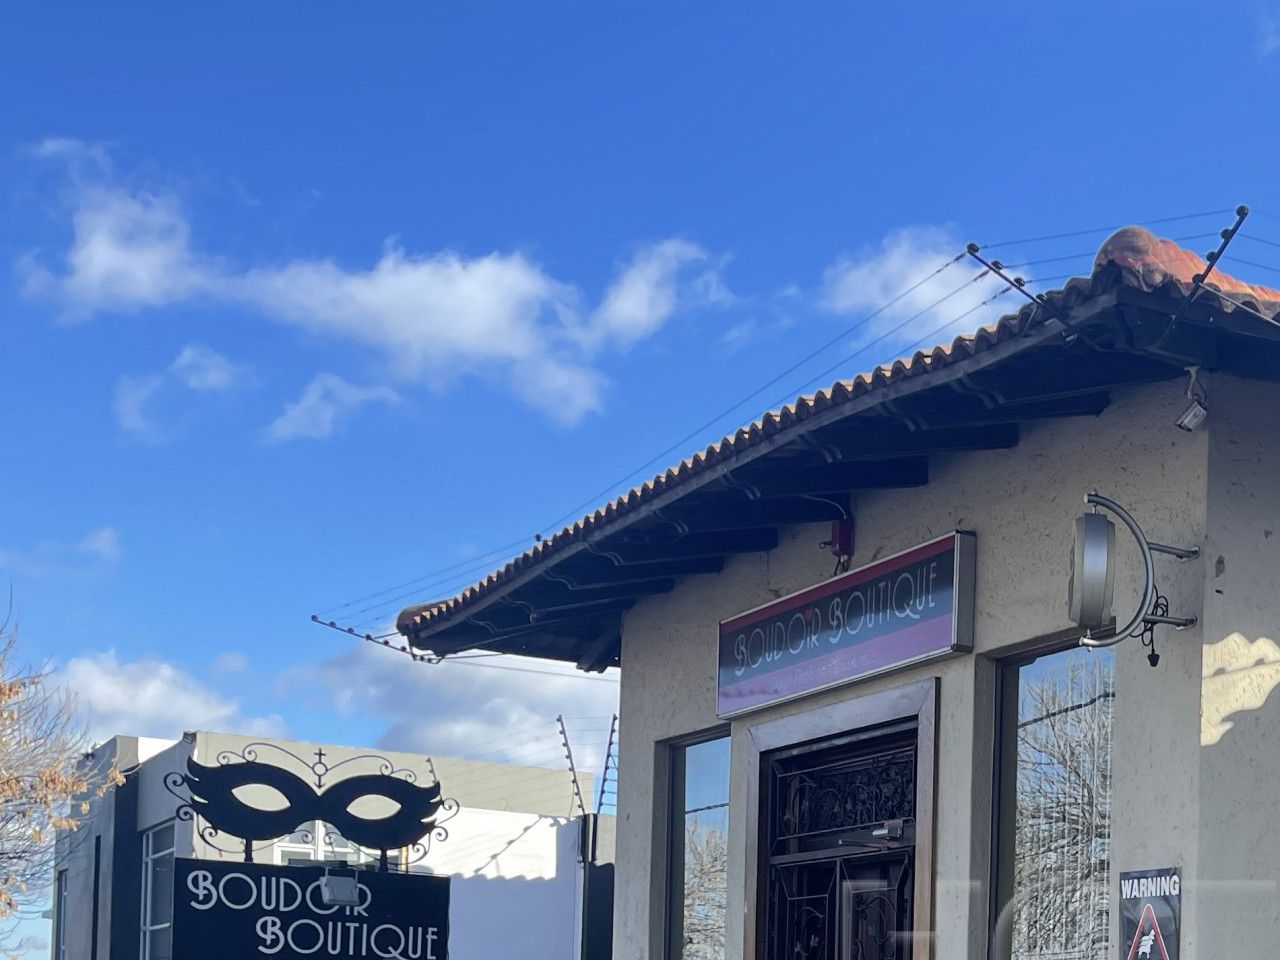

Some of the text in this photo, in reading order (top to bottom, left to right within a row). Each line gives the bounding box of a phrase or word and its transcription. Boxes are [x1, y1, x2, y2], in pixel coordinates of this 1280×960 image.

[734, 608, 822, 676] BOUDOIR
[828, 562, 938, 644] BOUTIQUE
[1121, 875, 1180, 899] WARNING
